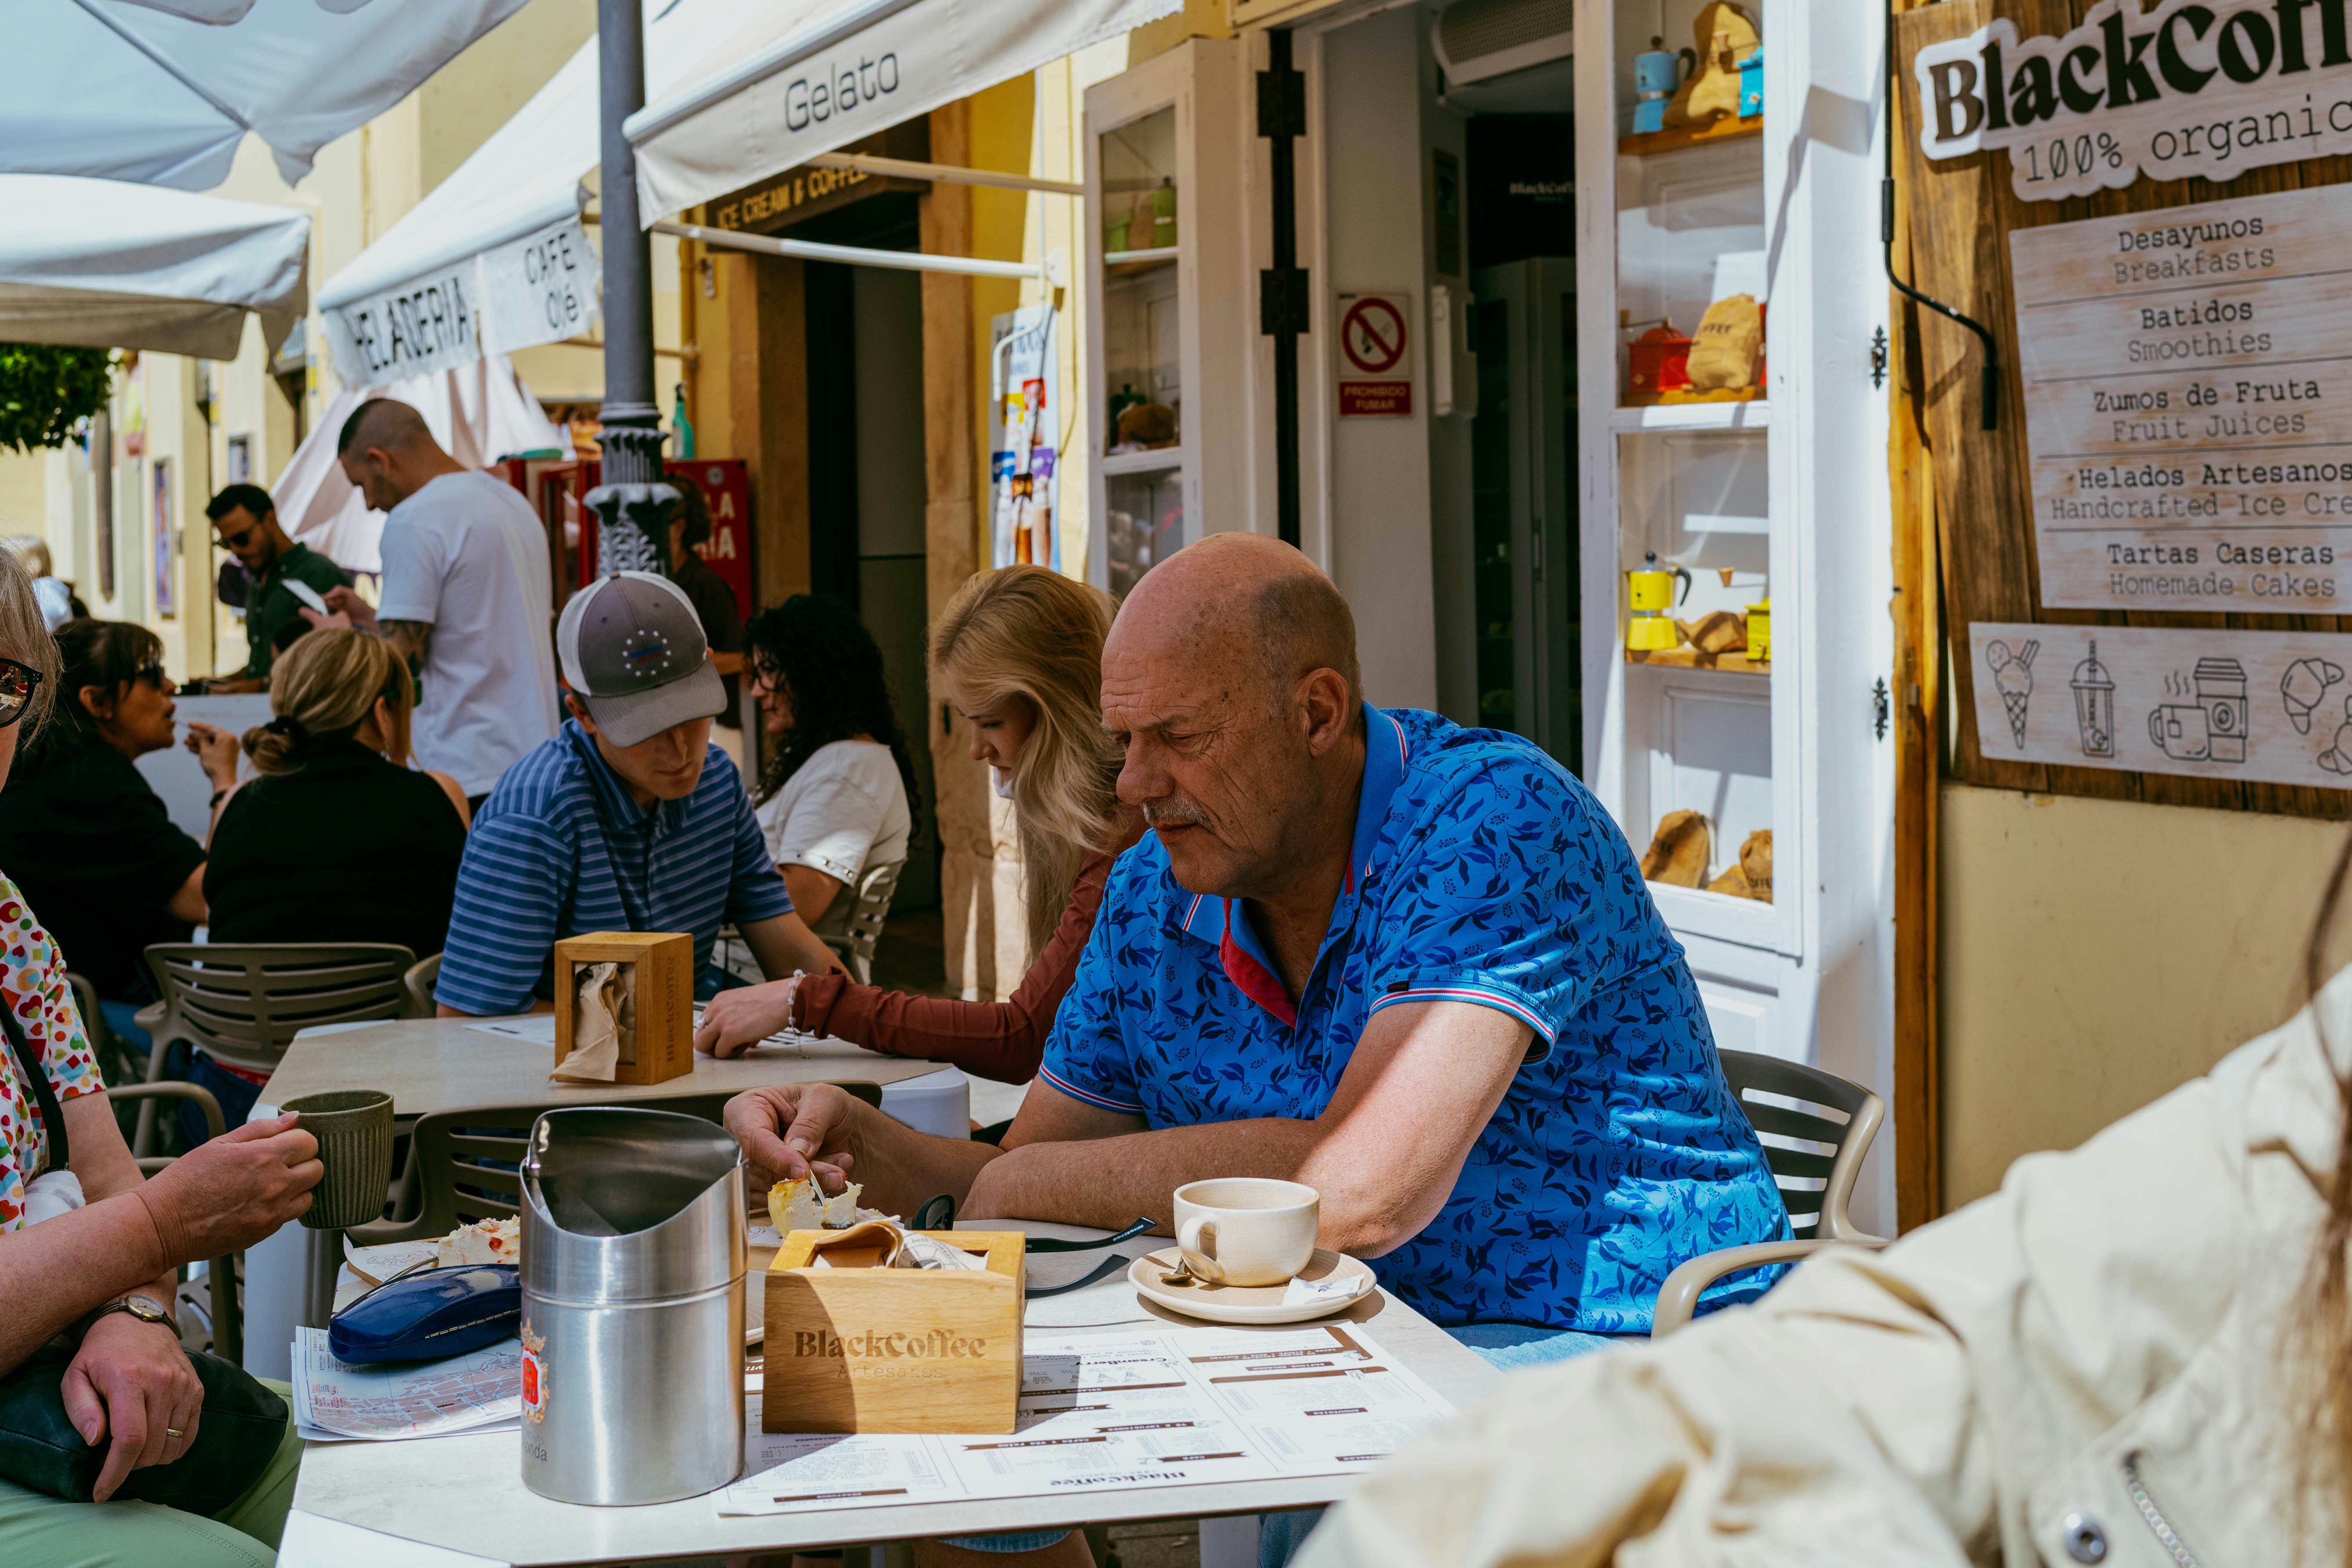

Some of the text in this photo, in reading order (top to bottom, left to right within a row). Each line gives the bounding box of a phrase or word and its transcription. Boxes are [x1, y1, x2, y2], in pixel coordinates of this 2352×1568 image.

[784, 52, 899, 133] Gelato
[2022, 132, 2122, 183] 100%
[741, 182, 790, 225] CREAM
[2119, 217, 2264, 252] Desayunos
[2114, 248, 2276, 285] Breakfasts
[2141, 300, 2254, 330] Batidos
[2128, 330, 2272, 363] Smoothies
[1344, 385, 1406, 397] PROHIBIDO
[1355, 399, 1396, 410] FUMAR
[2094, 379, 2321, 412] Zumos de Fruta
[2113, 411, 2306, 441] Fruit Juices
[2079, 462, 2352, 489] Helados Artesanos
[2051, 494, 2219, 520] Handcrafted
[2238, 494, 2286, 516] Ice
[2108, 543, 2334, 565] Tartas Caseras
[2110, 573, 2336, 598] Homemade Cakes
[794, 1328, 986, 1359] BlackCoffee
[836, 1364, 944, 1379] Artesanos
[1075, 1357, 1168, 1366] CreamBerry
[1050, 1471, 1187, 1486] BlackCoffee
